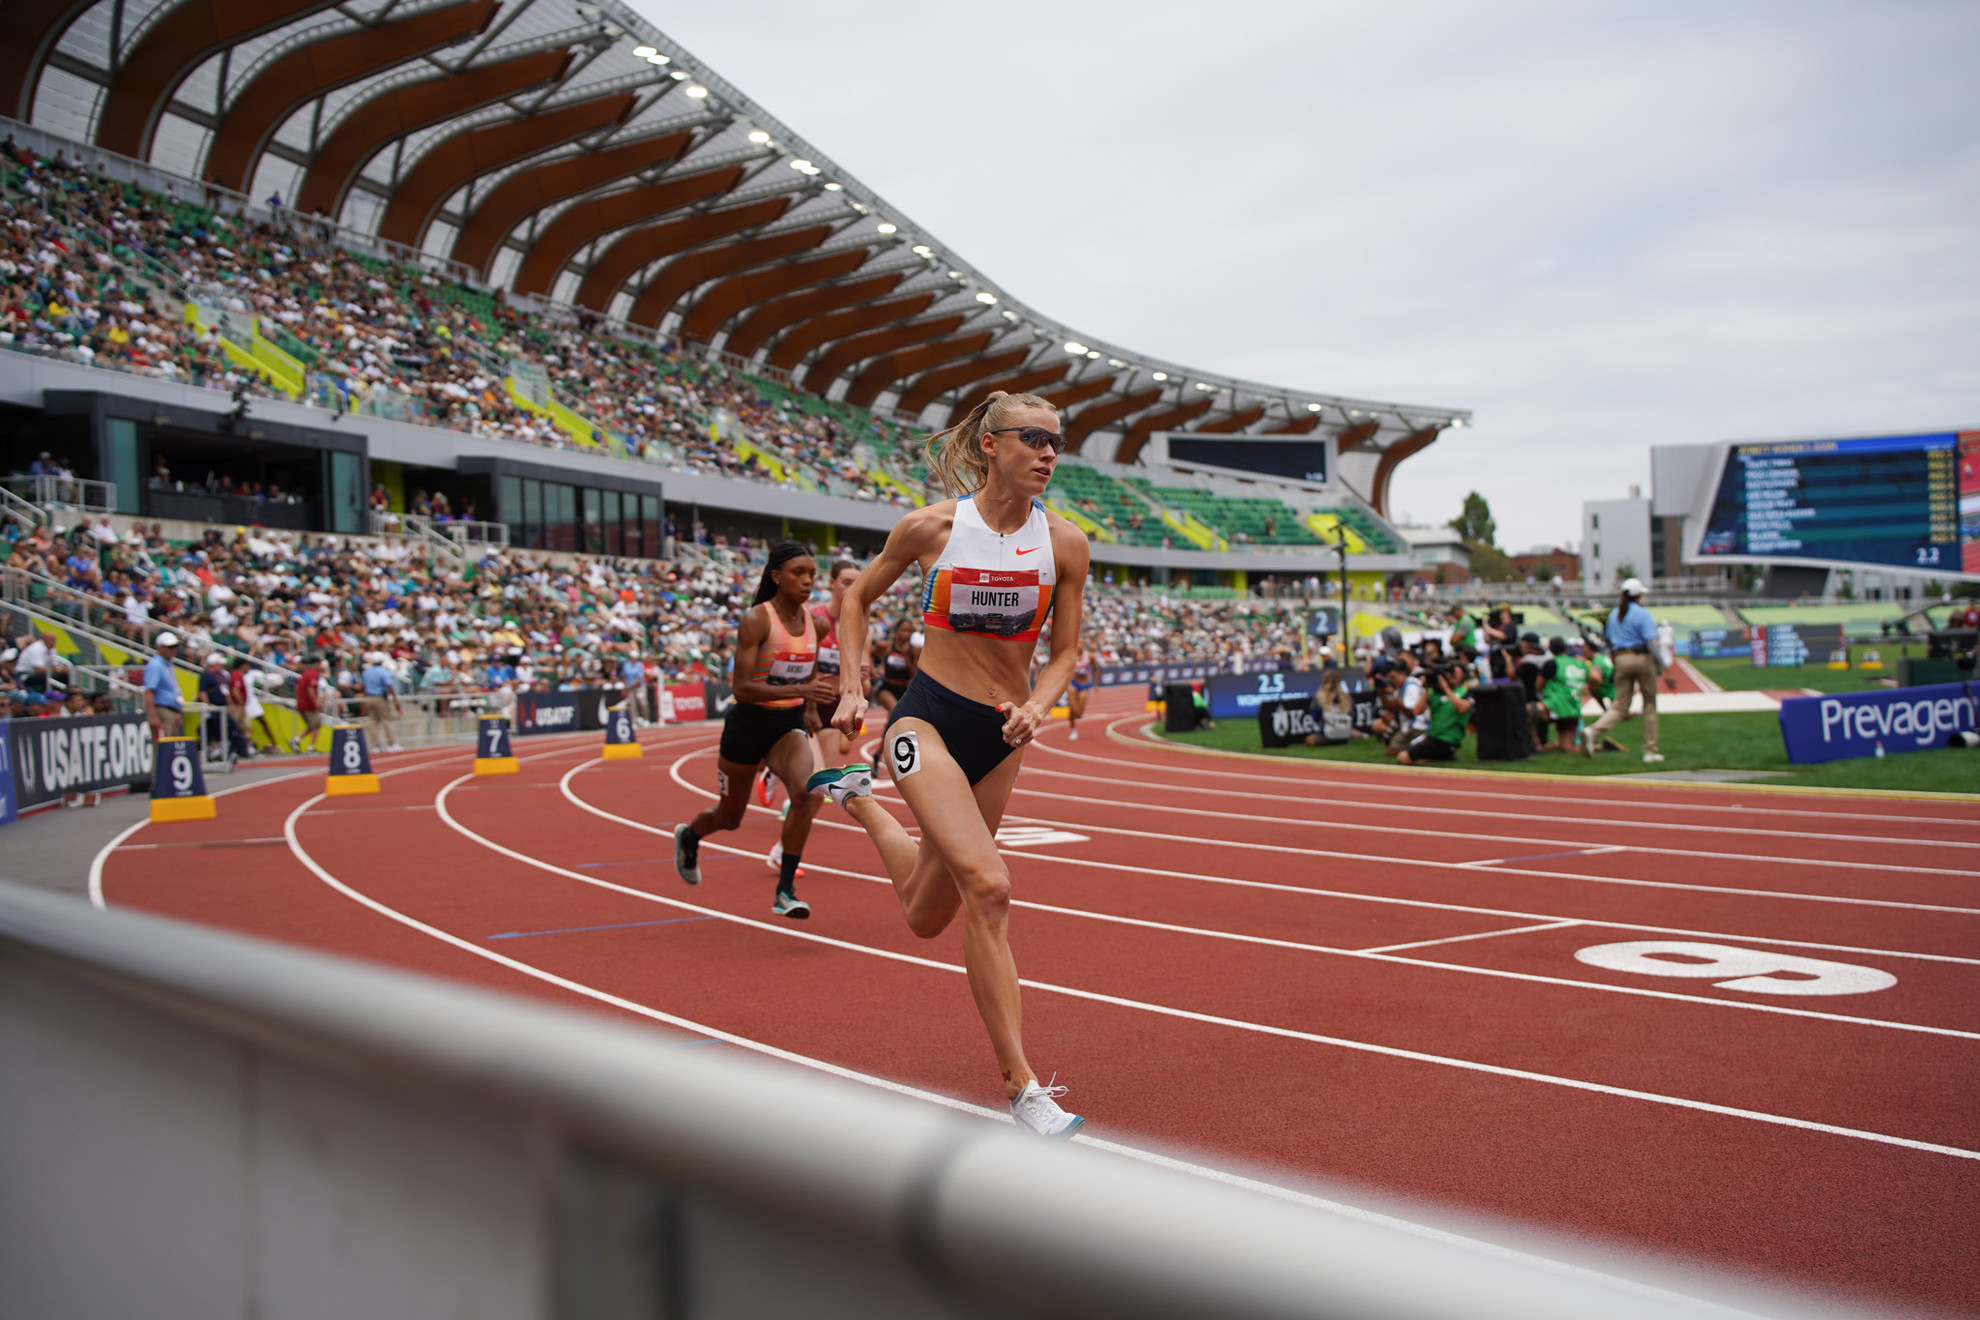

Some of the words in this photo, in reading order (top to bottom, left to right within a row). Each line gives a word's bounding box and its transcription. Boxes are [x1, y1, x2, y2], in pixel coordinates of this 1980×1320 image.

[971, 590, 1019, 607] HUNTER
[1314, 611, 1328, 635] 2
[1257, 674, 1285, 693] 2.5
[535, 706, 575, 727] USATF
[616, 717, 631, 738] 6
[1821, 697, 1976, 745] Prevagen
[343, 739, 362, 770] 8
[486, 729, 503, 753] 7
[40, 720, 153, 791] USATF.ORG
[895, 736, 915, 774] 9
[171, 755, 194, 791] 9
[1573, 940, 1898, 996] 9
